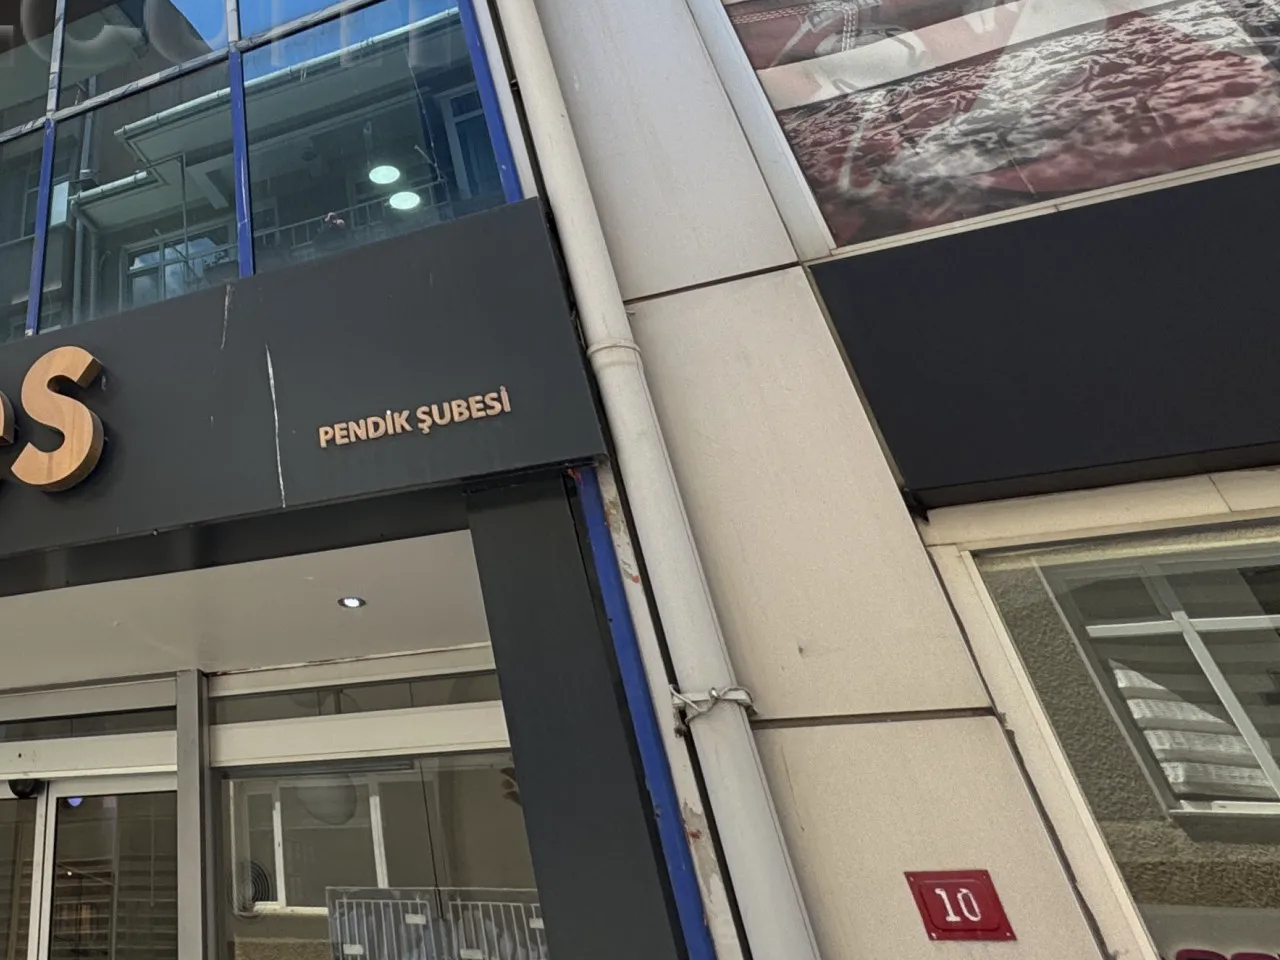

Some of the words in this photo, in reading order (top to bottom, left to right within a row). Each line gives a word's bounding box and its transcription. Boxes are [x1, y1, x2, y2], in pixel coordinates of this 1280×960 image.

[318, 409, 413, 448] PENDİK
[416, 385, 511, 434] ŞUBESİ
[934, 888, 982, 922] 10
